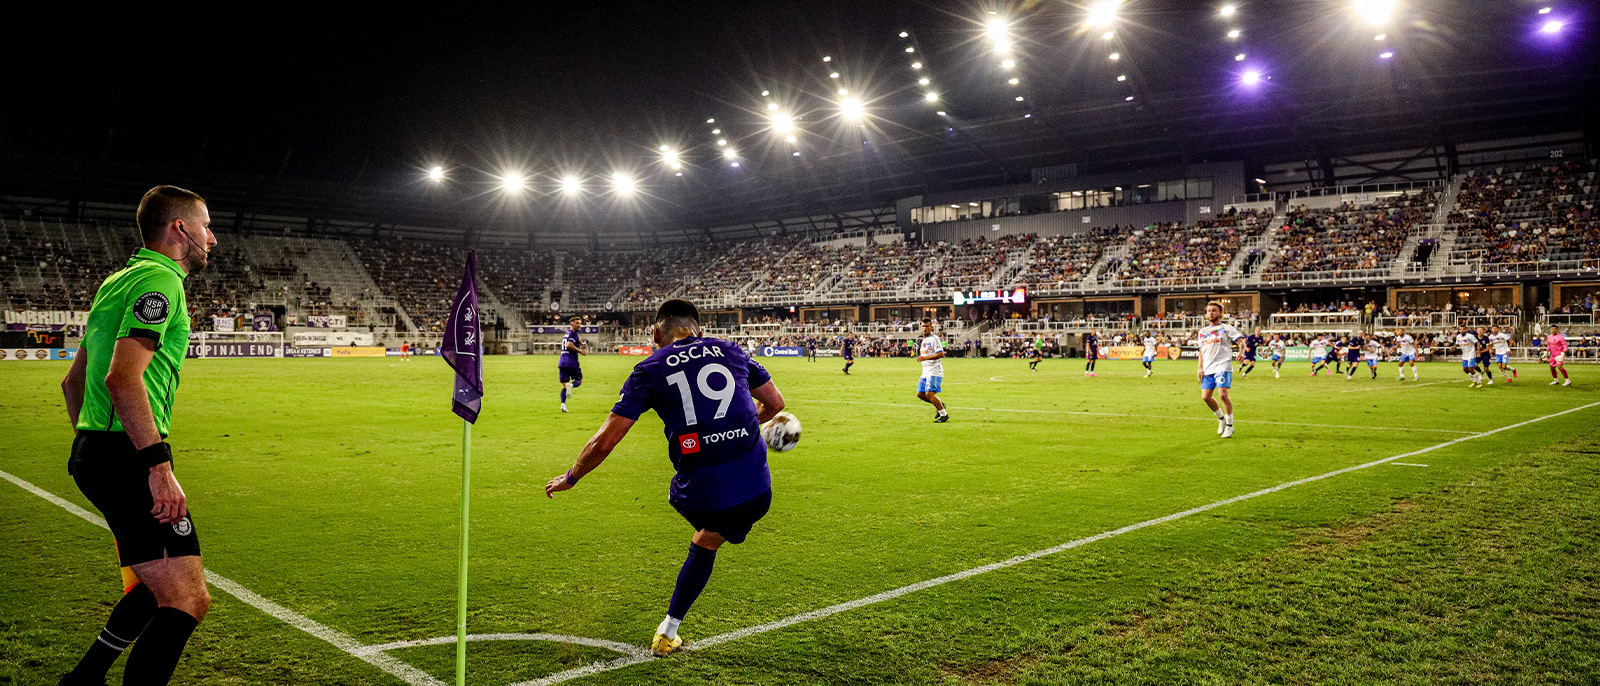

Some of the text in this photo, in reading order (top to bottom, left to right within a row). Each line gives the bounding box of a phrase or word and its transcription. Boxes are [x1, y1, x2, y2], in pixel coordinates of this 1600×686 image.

[1550, 150, 1563, 158] 202
[146, 299, 163, 308] USA
[5, 310, 89, 325] UNBRIDLE
[249, 344, 273, 356] END
[666, 345, 725, 367] OSCAR
[666, 363, 736, 427] 19
[703, 428, 749, 444] TOYOTA
